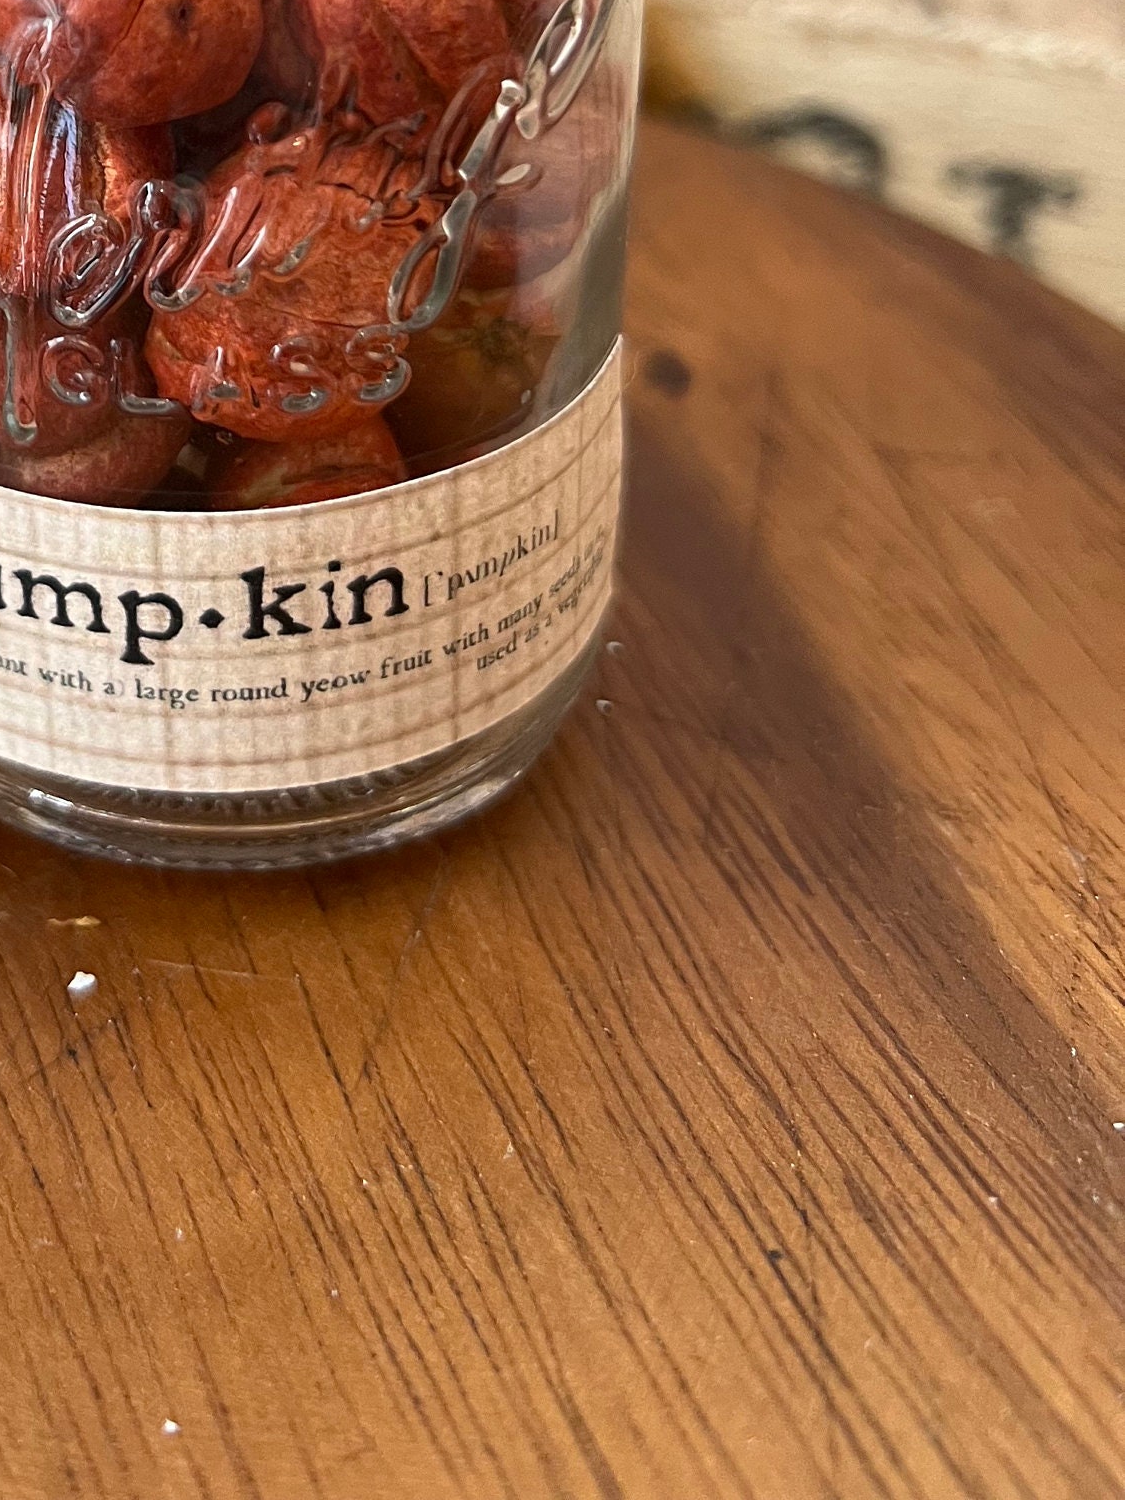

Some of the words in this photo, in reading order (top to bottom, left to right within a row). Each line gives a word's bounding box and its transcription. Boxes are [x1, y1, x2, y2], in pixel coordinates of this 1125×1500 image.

[38, 666, 93, 693] with
[134, 677, 200, 710] large
[210, 676, 290, 702] round
[299, 668, 372, 704] yeow
[379, 648, 433, 680] fruit
[441, 622, 490, 656] with
[496, 591, 544, 634] many
[475, 630, 518, 671] used
[524, 622, 541, 644] as
